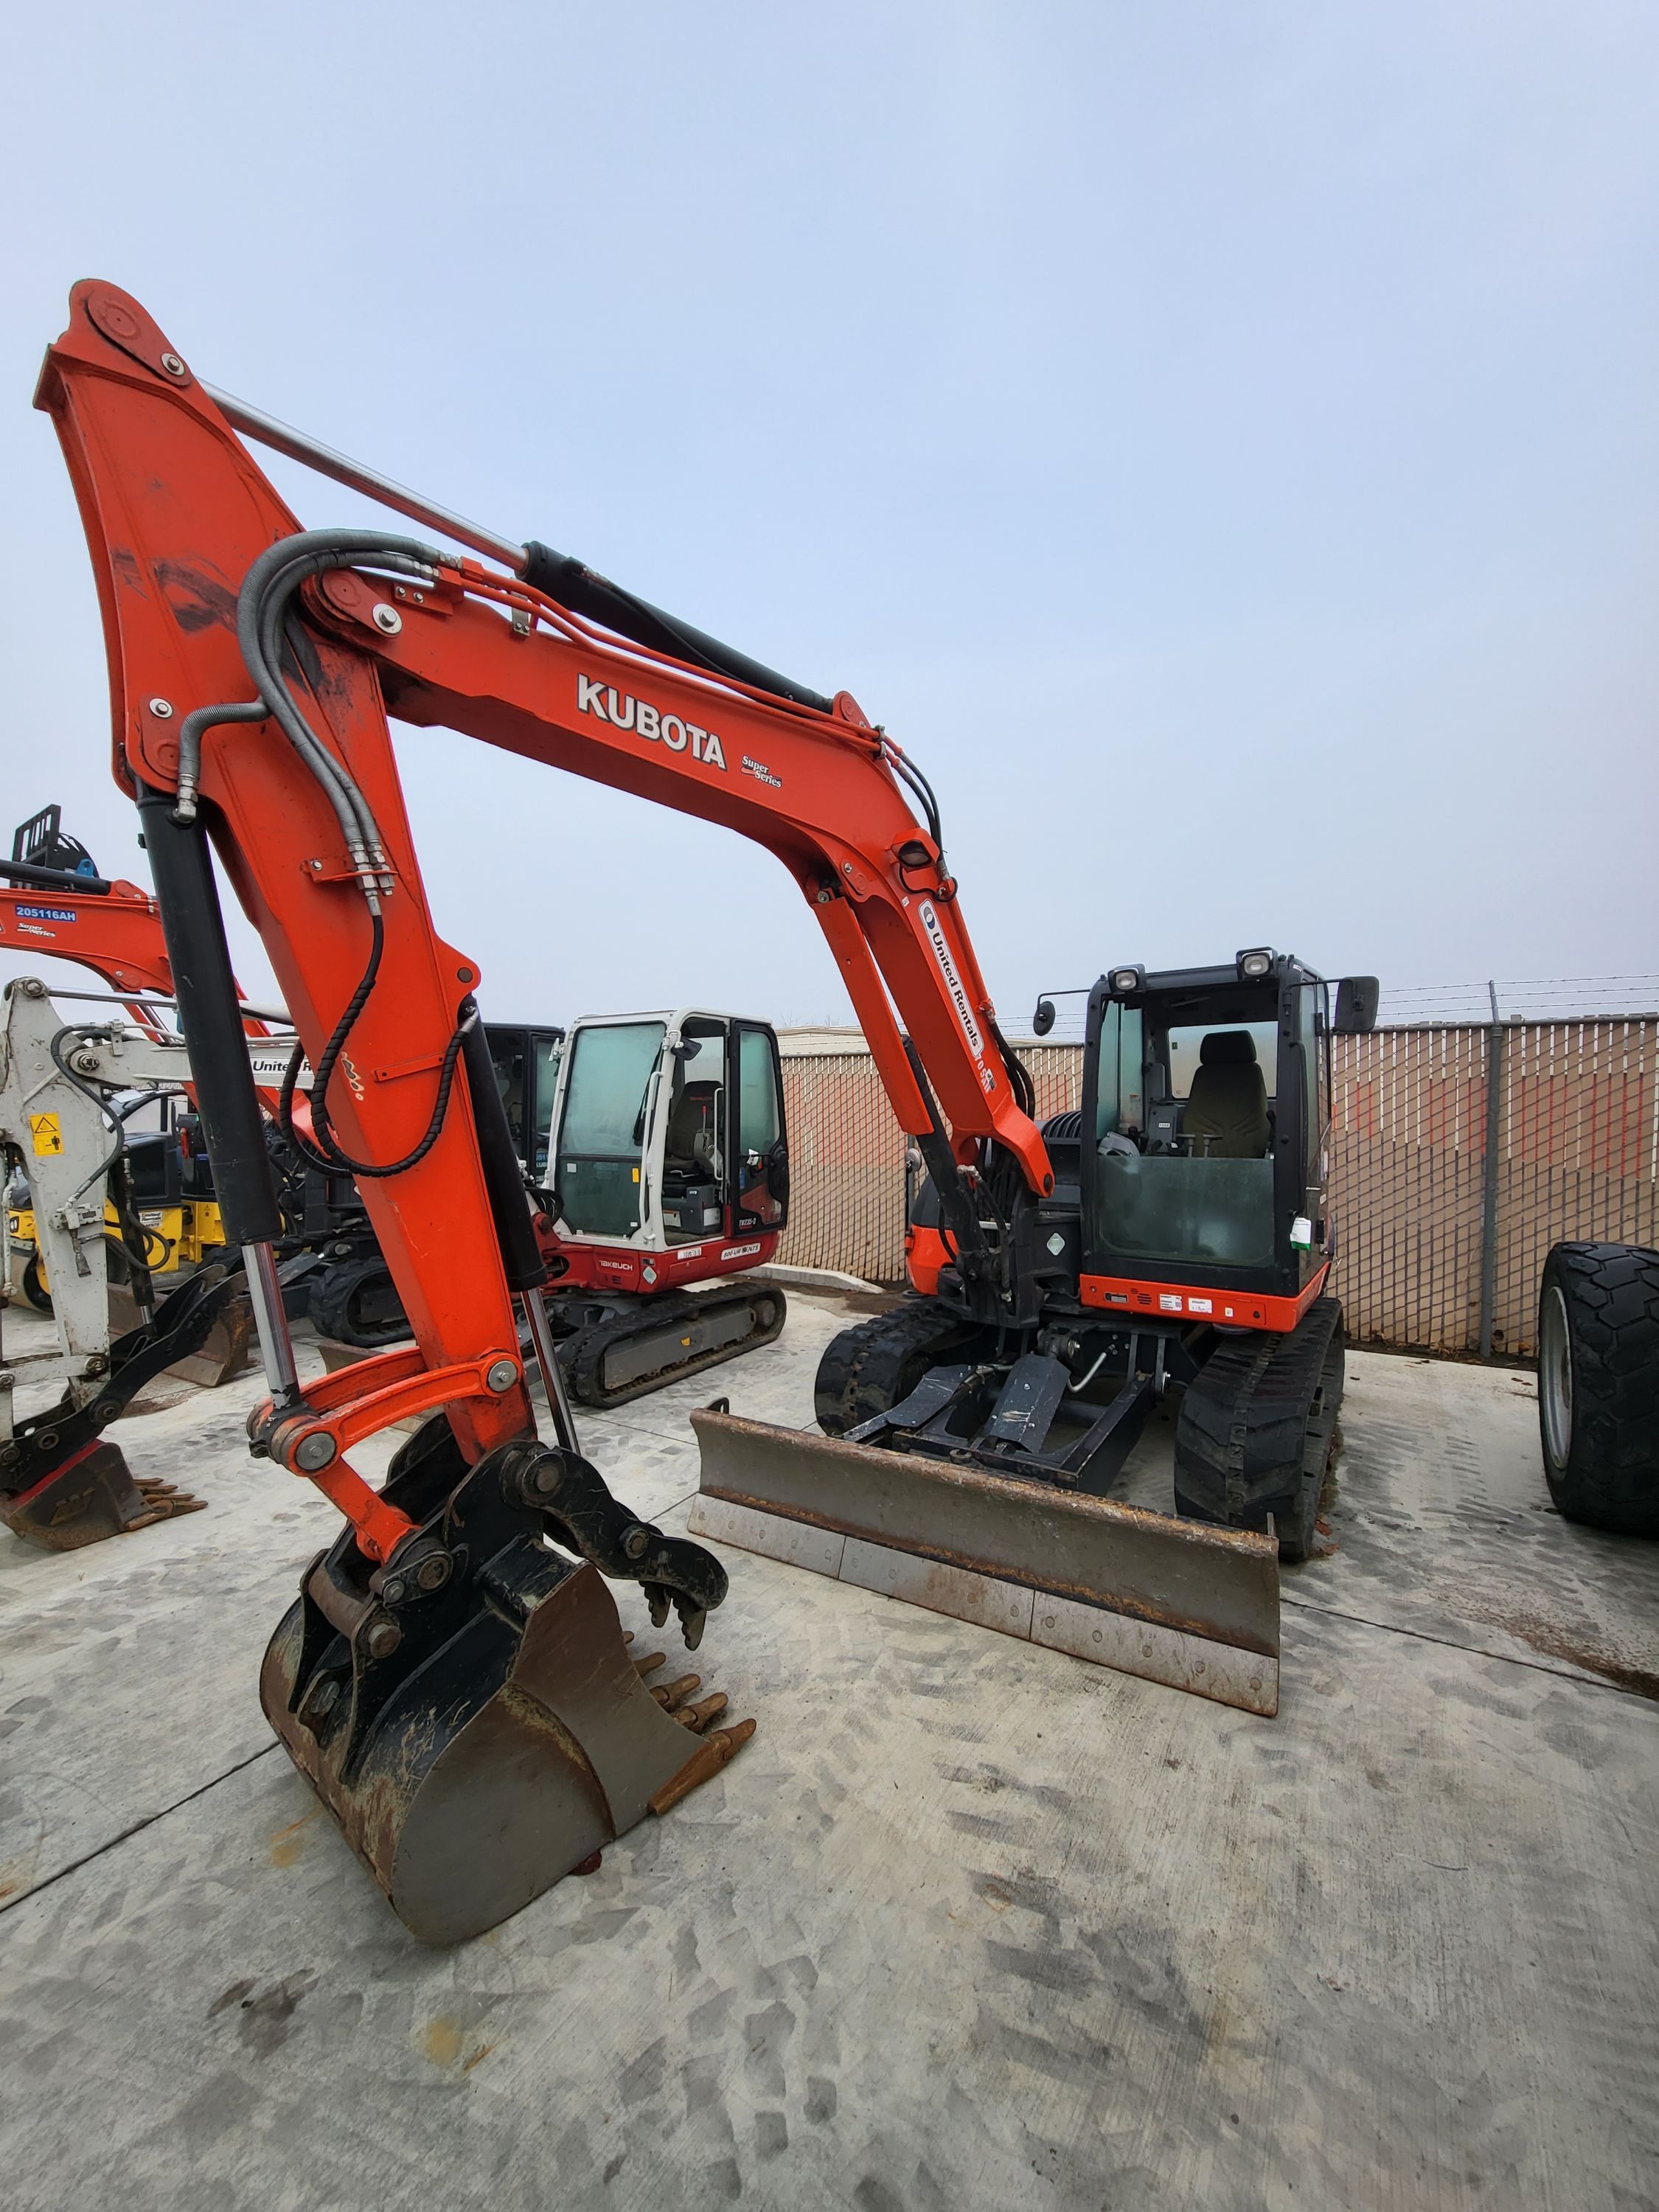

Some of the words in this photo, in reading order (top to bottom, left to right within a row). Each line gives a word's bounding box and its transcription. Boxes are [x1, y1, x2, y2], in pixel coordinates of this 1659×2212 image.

[578, 673, 728, 771] KUBOTA
[742, 756, 769, 773] Super
[754, 770, 782, 788] Series
[16, 906, 76, 922] 205116AH
[933, 932, 958, 987] United
[954, 990, 980, 1047] Rentals
[252, 1060, 290, 1071] Unite
